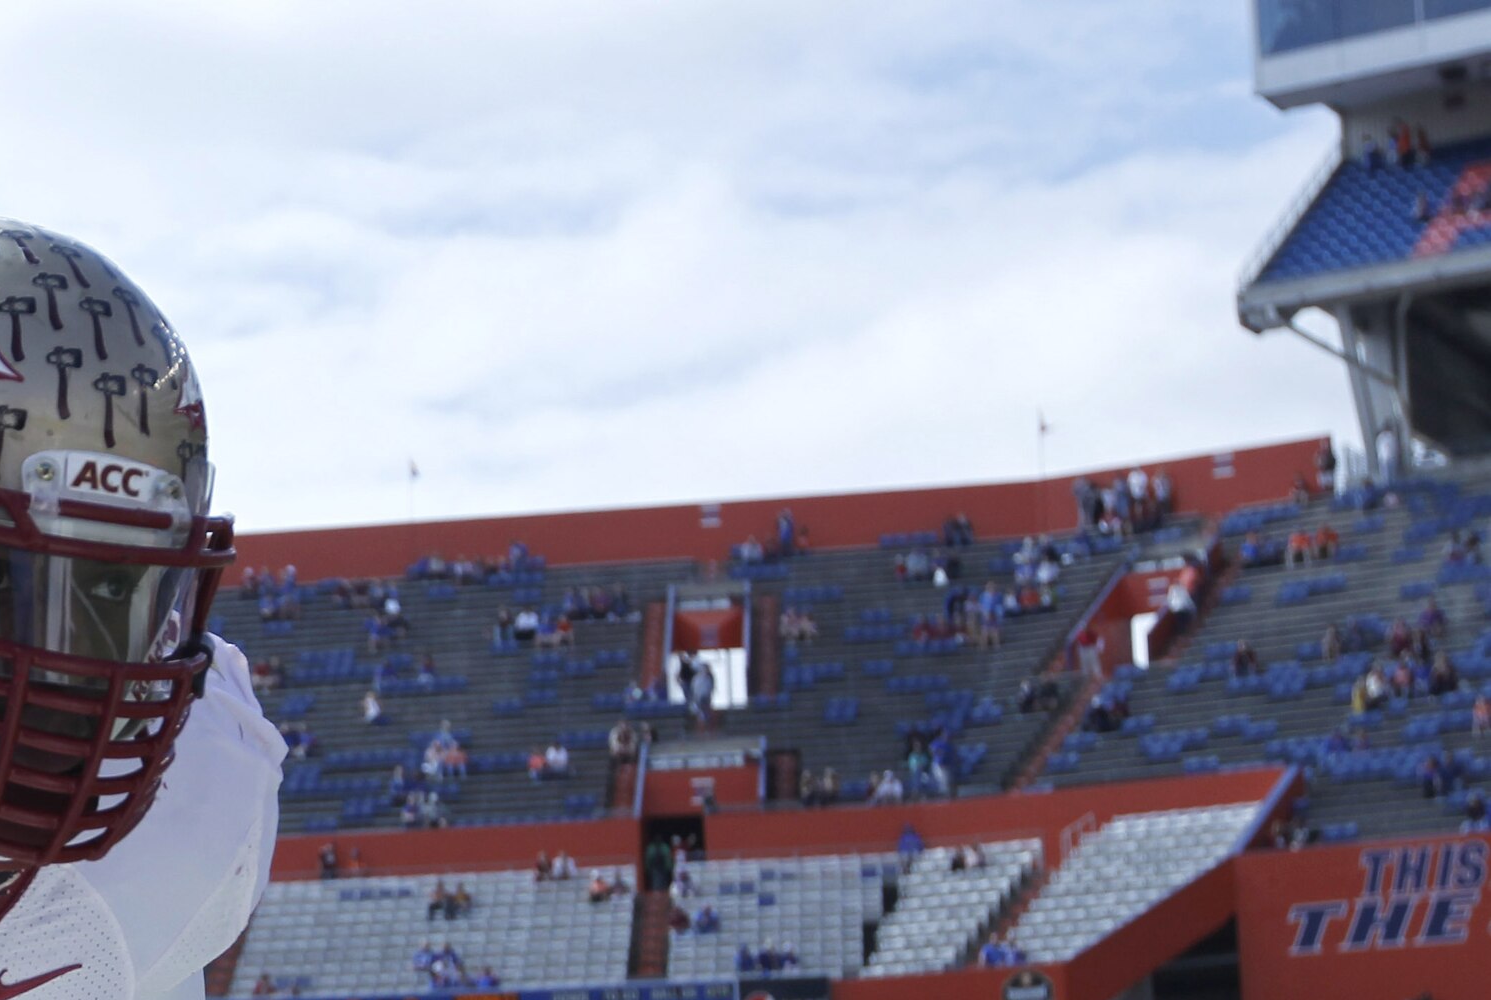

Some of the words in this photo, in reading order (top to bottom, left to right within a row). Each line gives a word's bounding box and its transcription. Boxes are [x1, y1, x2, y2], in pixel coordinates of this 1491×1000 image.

[71, 460, 143, 497] ACC
[1360, 839, 1489, 898] THIS
[1286, 888, 1481, 957] THE
